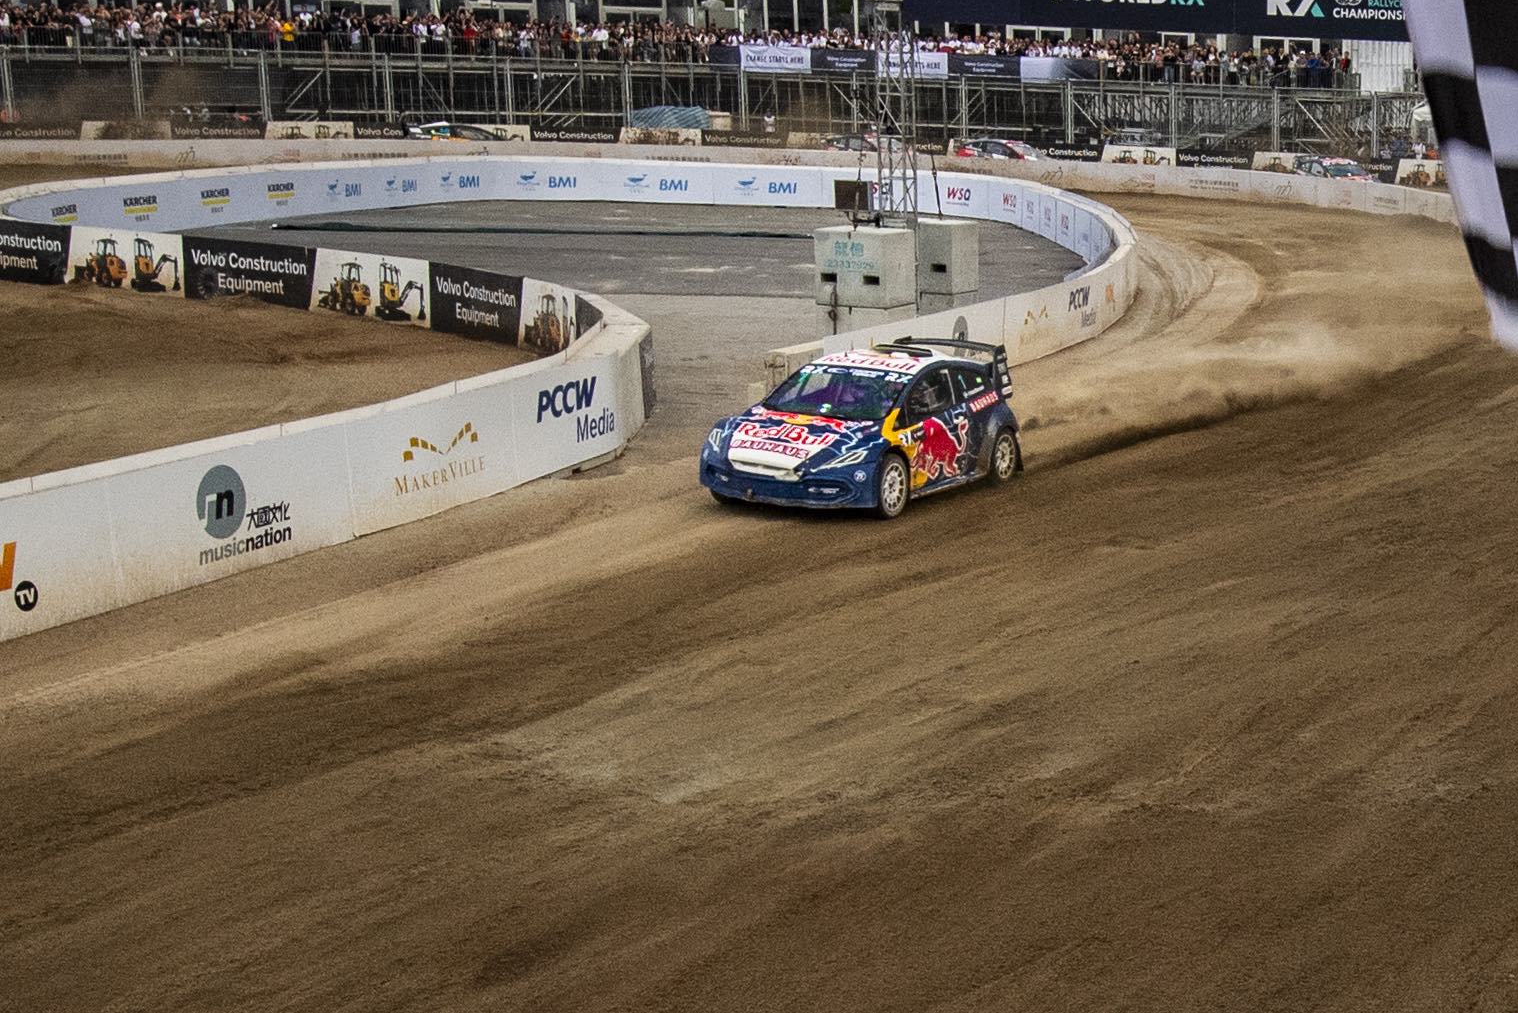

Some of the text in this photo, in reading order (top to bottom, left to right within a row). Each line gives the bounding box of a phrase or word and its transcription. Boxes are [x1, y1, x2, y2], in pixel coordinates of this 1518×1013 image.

[202, 127, 261, 136] Construction
[357, 128, 381, 136] Volvo
[533, 131, 614, 140] Volvo Construction
[1048, 147, 1097, 157] Construction
[1179, 153, 1248, 164] Volvo Construction
[459, 175, 480, 189] BMI
[548, 176, 577, 189] BMI
[659, 179, 688, 191] BMI
[768, 182, 797, 194] BMI
[191, 249, 307, 276] Volvo Construction
[218, 272, 284, 295] Equipment
[436, 275, 517, 308] Volvo Construction
[455, 303, 499, 329] Equipment
[537, 376, 596, 423] PCCW
[576, 407, 615, 443] Media
[739, 422, 837, 446] Red Bull
[730, 439, 809, 459] BAUHAUS
[245, 501, 290, 531] 大國文化
[199, 526, 292, 566] musicnation
[16, 588, 36, 606] TV
